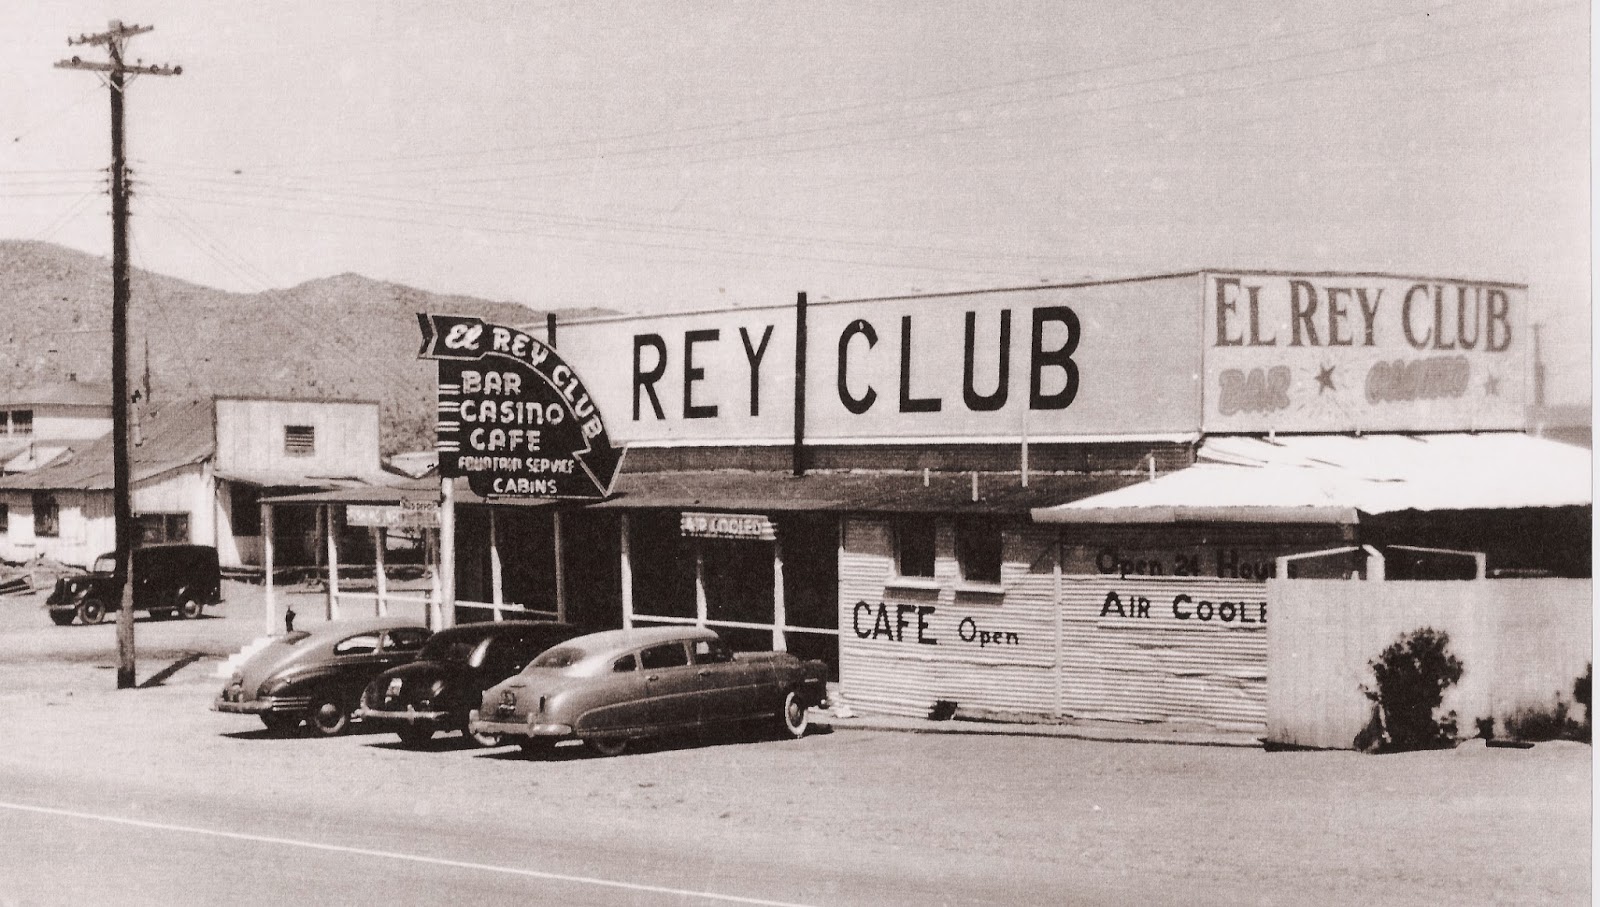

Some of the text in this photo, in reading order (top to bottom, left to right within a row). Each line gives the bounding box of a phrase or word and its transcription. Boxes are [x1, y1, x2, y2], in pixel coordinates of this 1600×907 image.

[1213, 277, 1512, 353] EL REY CLUB
[632, 305, 1081, 420] REY CLUB
[445, 324, 603, 439] El REY CLUB
[461, 370, 521, 394] BAR
[1219, 364, 1292, 417] BAR
[460, 400, 564, 425] CASINO
[469, 428, 541, 451] CAFE
[458, 456, 575, 474] FOUNTAIN SERVICE
[493, 477, 558, 494] CABINS
[1096, 547, 1162, 580] Open
[1173, 554, 1201, 577] 24
[1099, 592, 1151, 619] AIR
[852, 600, 1020, 648] CAFE Open
